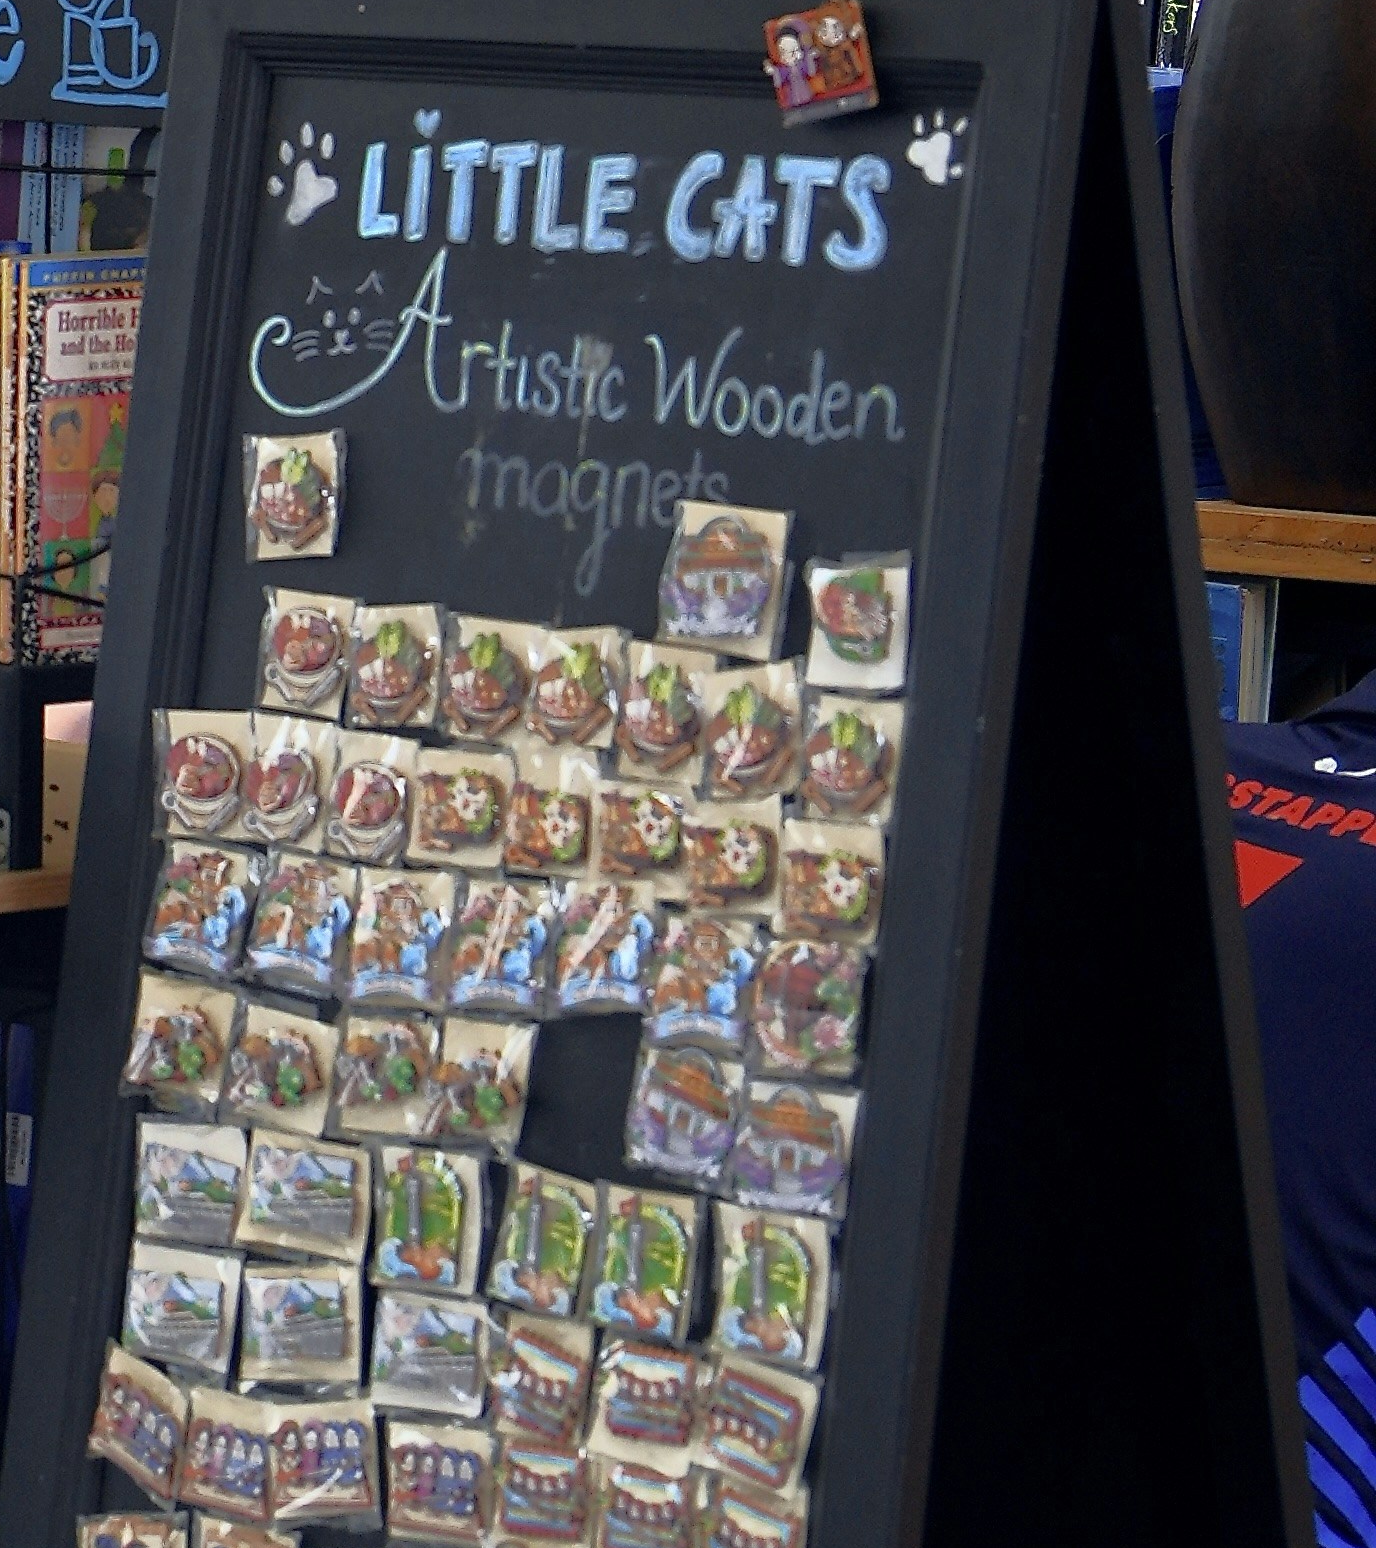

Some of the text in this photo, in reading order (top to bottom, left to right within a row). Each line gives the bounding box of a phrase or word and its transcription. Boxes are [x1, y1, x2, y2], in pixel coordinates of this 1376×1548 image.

[664, 150, 892, 270] CATS
[250, 246, 904, 447] Artistic Wooden
[460, 448, 730, 597] magnets
[1227, 773, 1376, 846] STAPP
